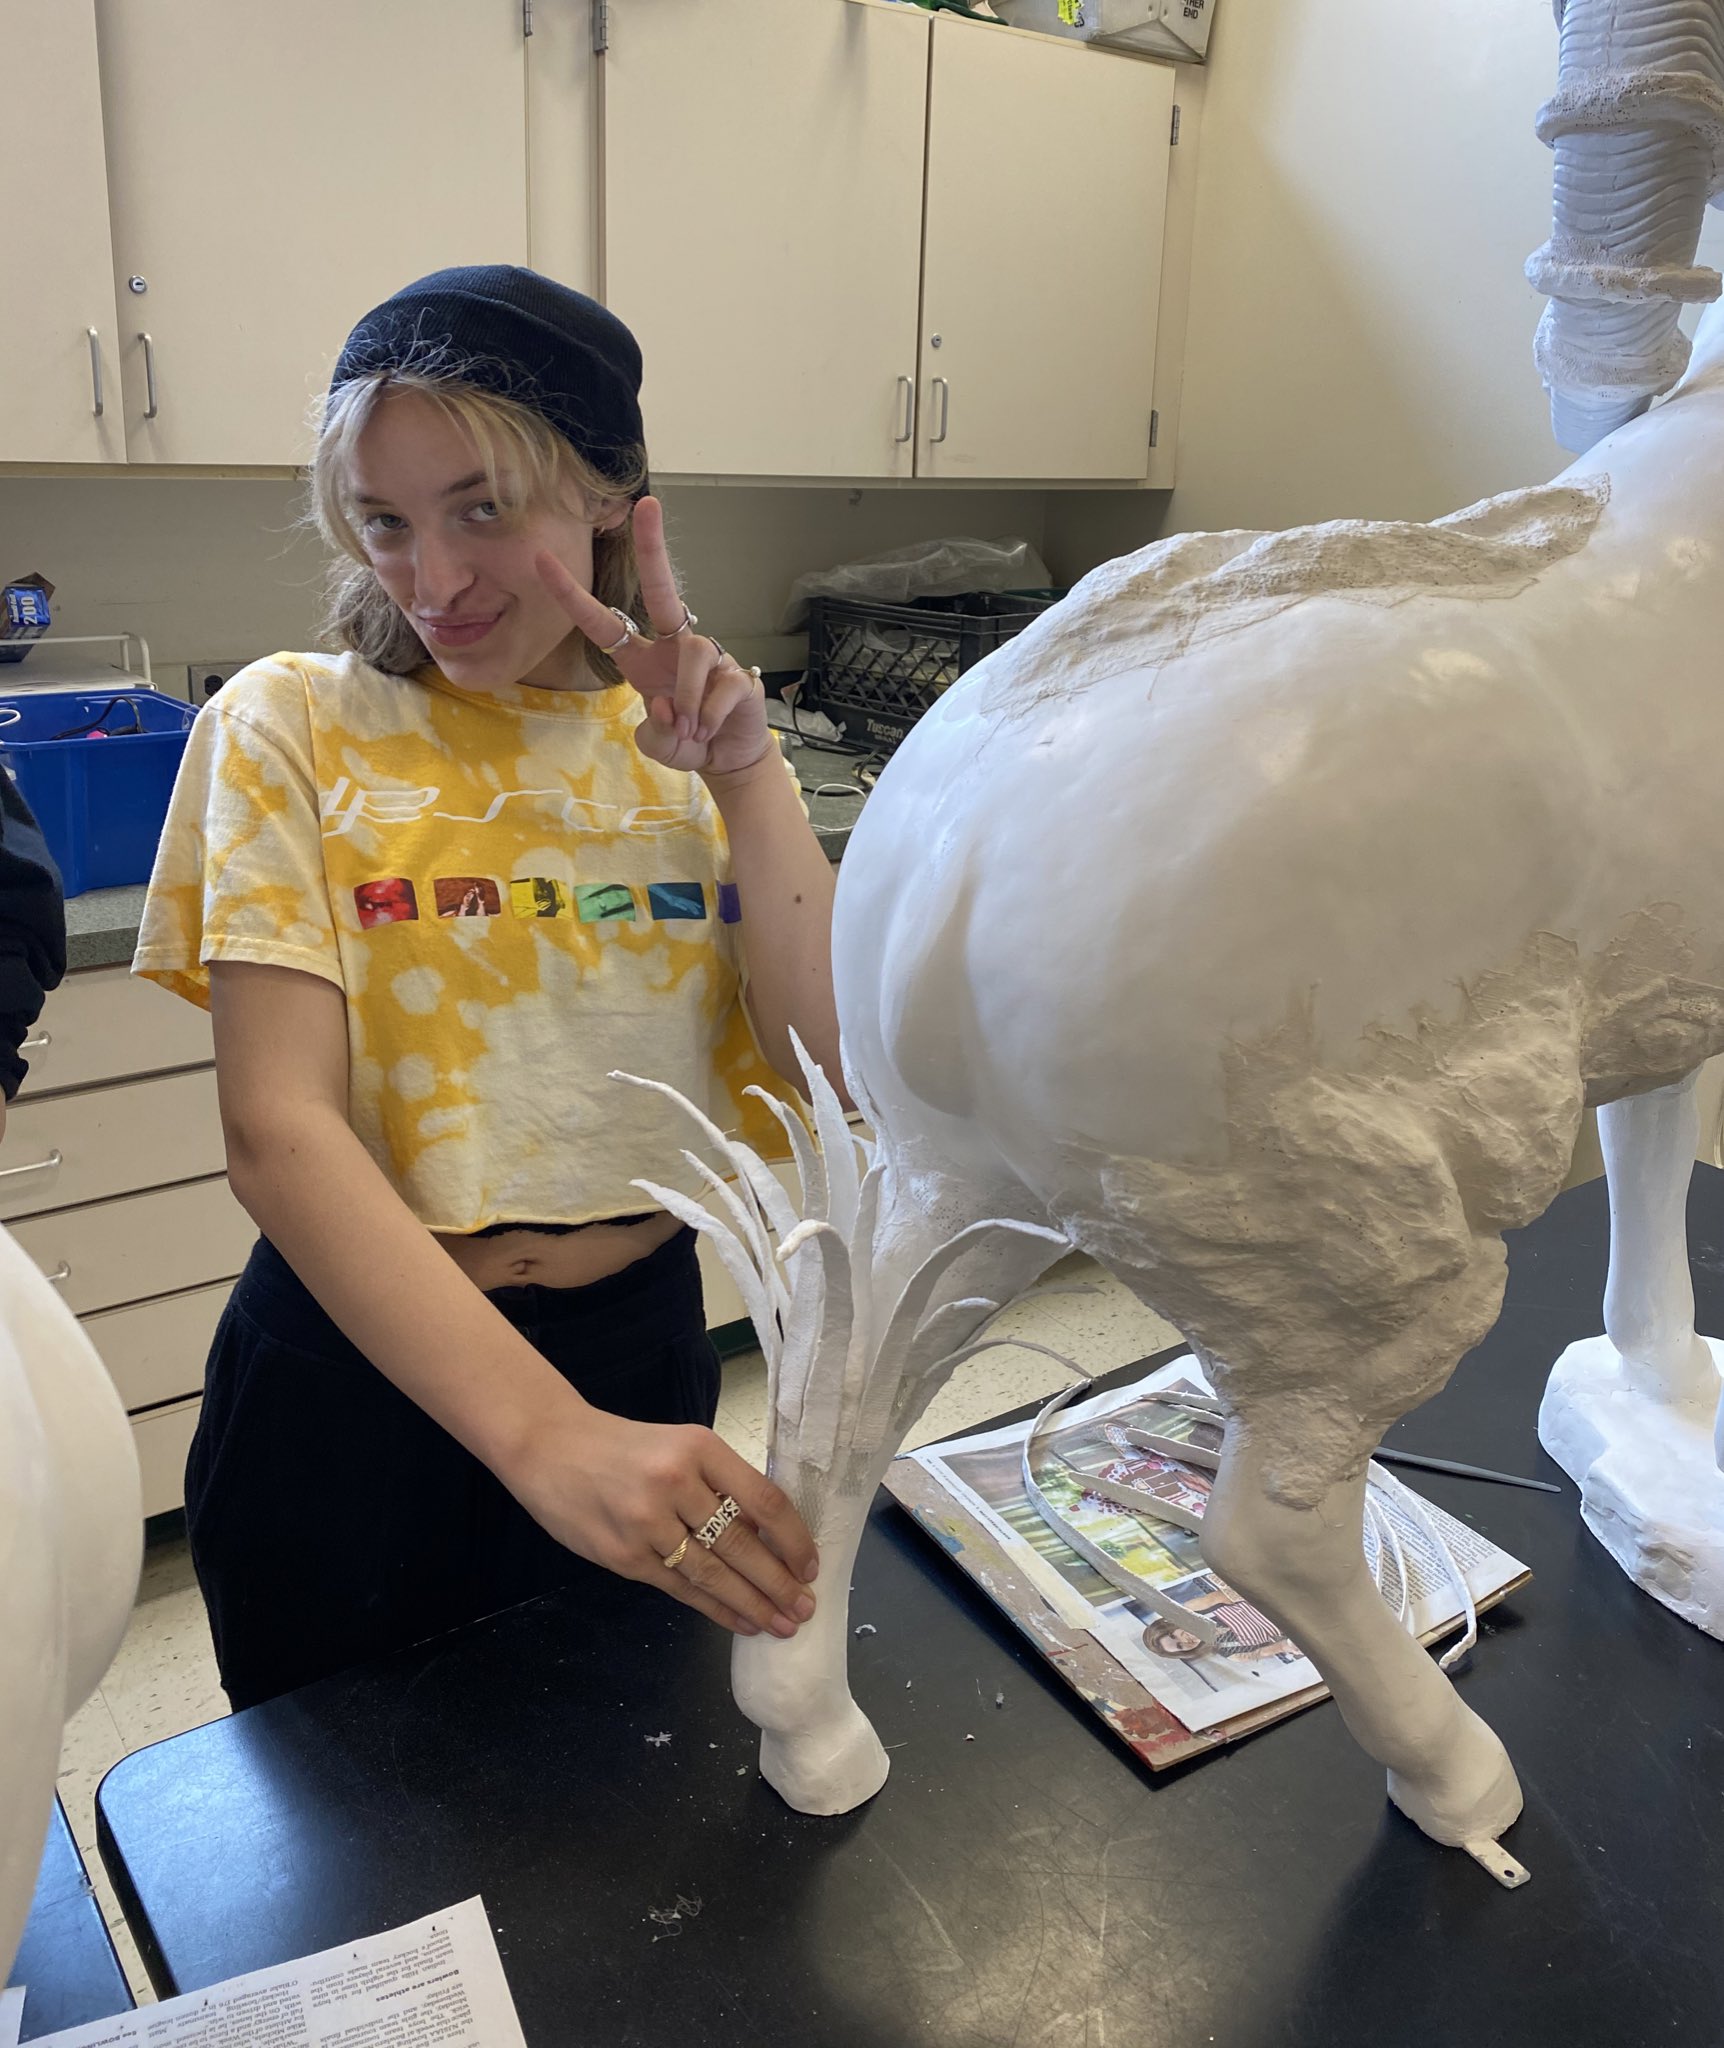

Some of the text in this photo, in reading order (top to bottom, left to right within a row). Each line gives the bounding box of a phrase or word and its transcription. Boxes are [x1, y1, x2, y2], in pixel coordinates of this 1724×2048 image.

[1183, 8, 1198, 20] END
[21, 596, 38, 625] 200
[867, 718, 904, 738] Tuscan
[392, 1946, 418, 1961] hockey
[435, 1948, 453, 1958] team
[370, 1957, 389, 1968] team
[404, 1955, 418, 1964] and
[413, 1957, 433, 1968] finals
[346, 1964, 367, 1976] made
[375, 1960, 401, 1974] several
[400, 1964, 411, 1973] for
[345, 1969, 373, 1984] players
[386, 1969, 398, 1977] the
[312, 1959, 445, 2008] Indian Hills qualified for the boys
[325, 1979, 343, 1990] from
[360, 1973, 384, 1986] eighth
[310, 1986, 322, 1995] the
[341, 1982, 357, 1992] time
[376, 1969, 459, 2003] Bowlers are athletes
[450, 1982, 462, 1990] are
[232, 1987, 267, 2002] averaged
[278, 1993, 299, 2003] vated
[311, 1991, 328, 2002] nine
[263, 2000, 277, 2008] and
[236, 2004, 260, 2017] driven
[254, 2010, 266, 2018] the
[268, 2006, 279, 2014] On
[402, 2006, 417, 2015] and
[420, 2009, 432, 2017] the
[387, 2012, 399, 2021] the
[401, 2013, 417, 2023] girls
[430, 2012, 443, 2021] The
[460, 2017, 473, 2026] the
[217, 2022, 227, 2030] he
[344, 2018, 383, 2035] individual
[378, 2020, 398, 2030] team
[81, 2030, 136, 2048] See BOWLIN
[319, 2032, 341, 2044] finals
[331, 2027, 375, 2046] tournament
